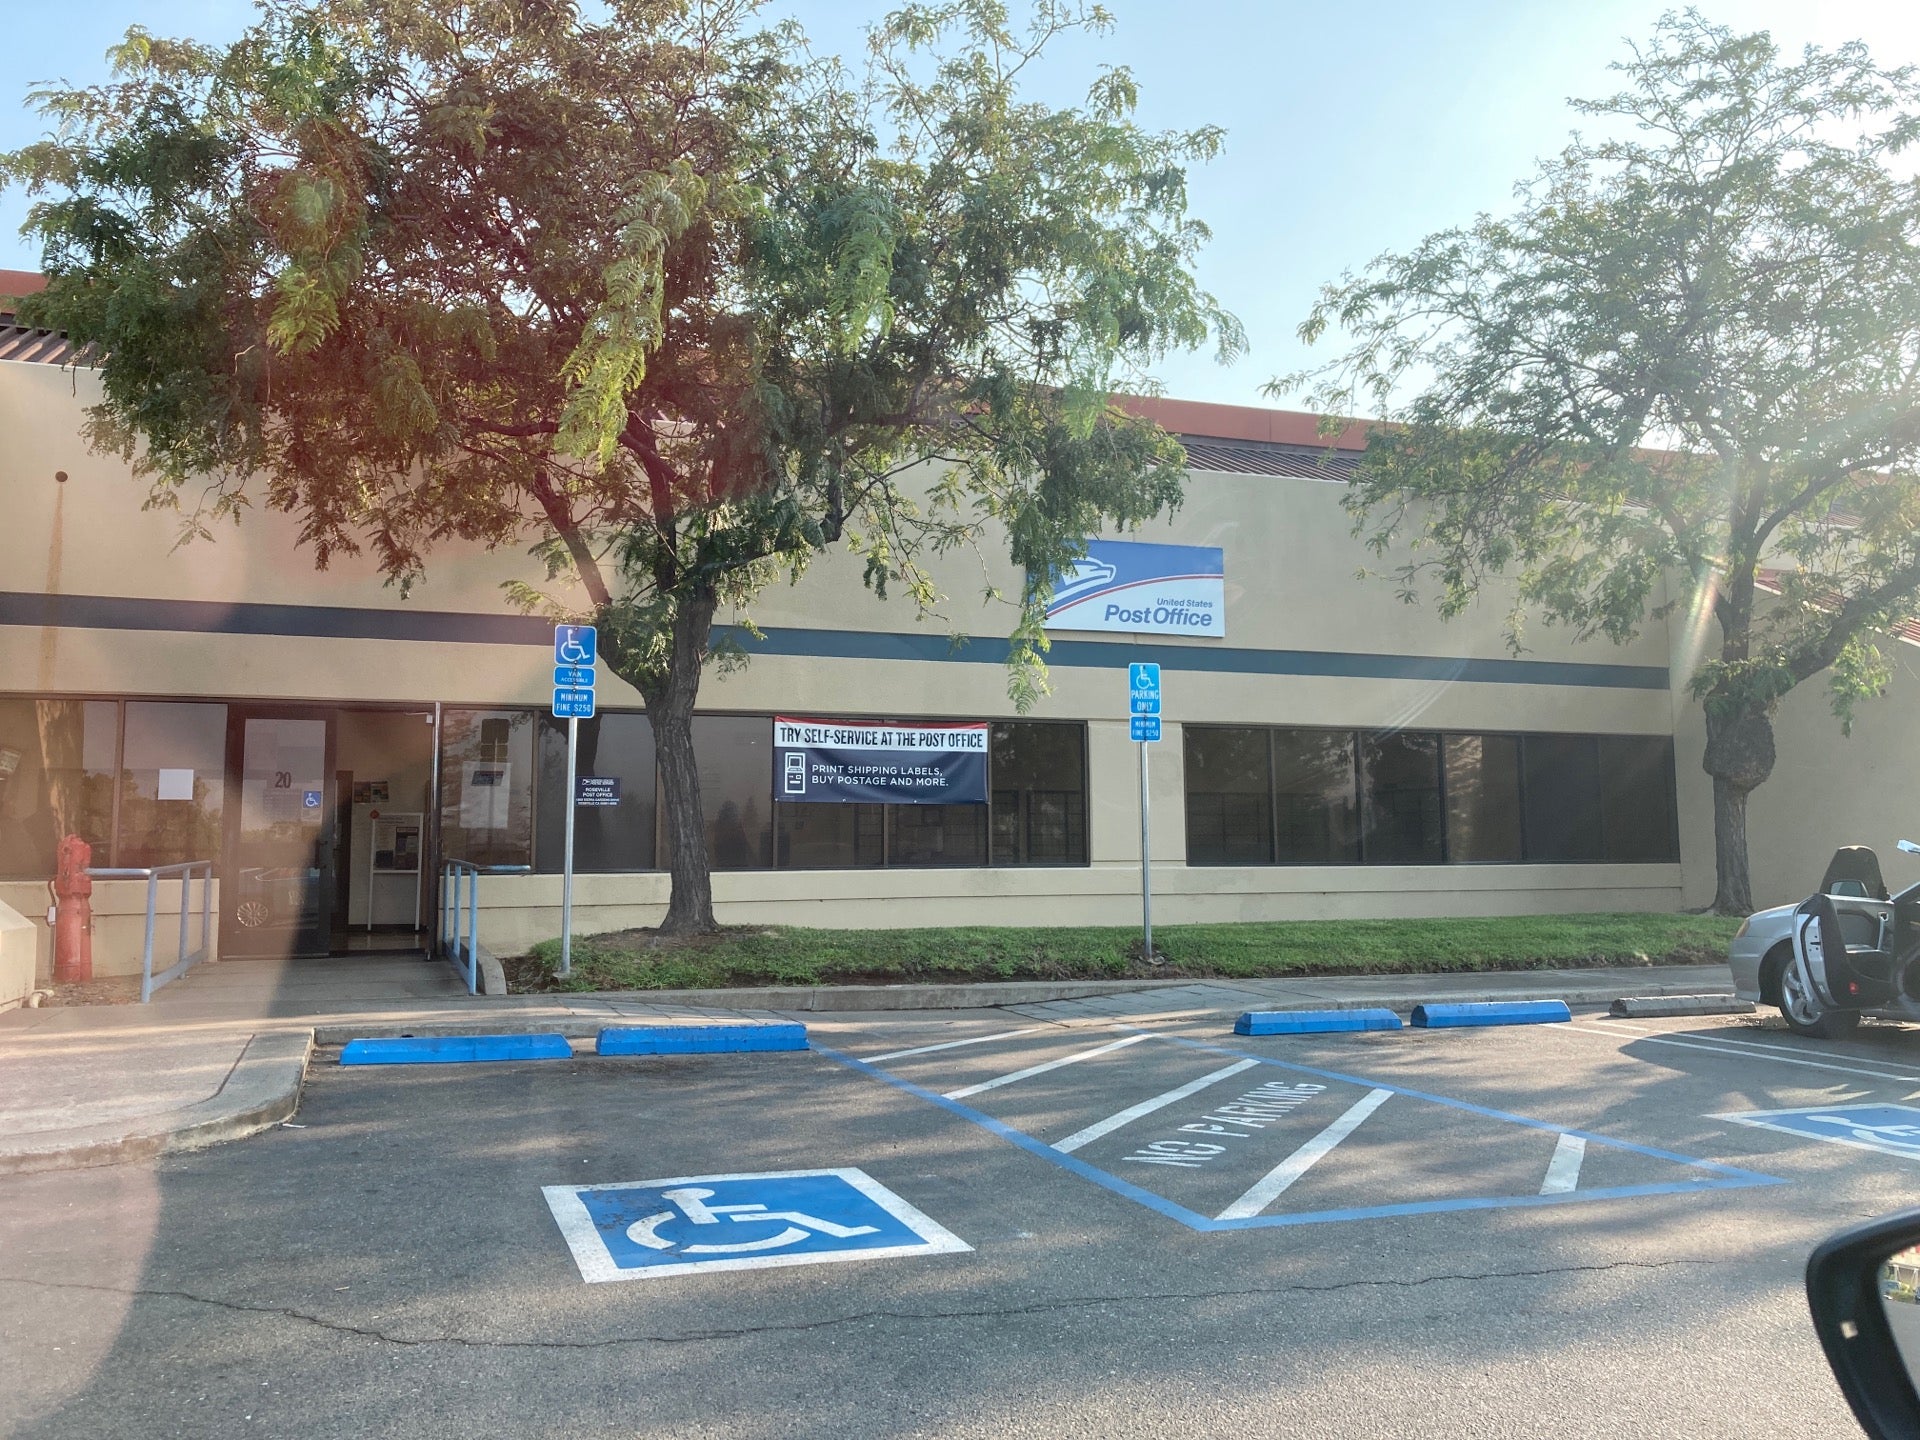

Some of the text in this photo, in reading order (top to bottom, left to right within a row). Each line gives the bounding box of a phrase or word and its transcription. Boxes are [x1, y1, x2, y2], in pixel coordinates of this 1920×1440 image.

[1156, 597, 1213, 608] United States
[1104, 604, 1213, 627] Post Office
[560, 692, 588, 702] MINIMUM
[1131, 689, 1159, 700] PARKING
[556, 703, 592, 712] FINE $250
[1136, 701, 1153, 712] ONLY
[780, 727, 983, 748] TRY SELF-SERVICE AT THE POST OFFICE
[812, 764, 943, 777] PRINT SHIPPING LABELS,
[275, 771, 291, 788] 20
[811, 775, 949, 787] BUY POSTAGE AND MORE.
[1121, 1081, 1328, 1168] NO PARKING
